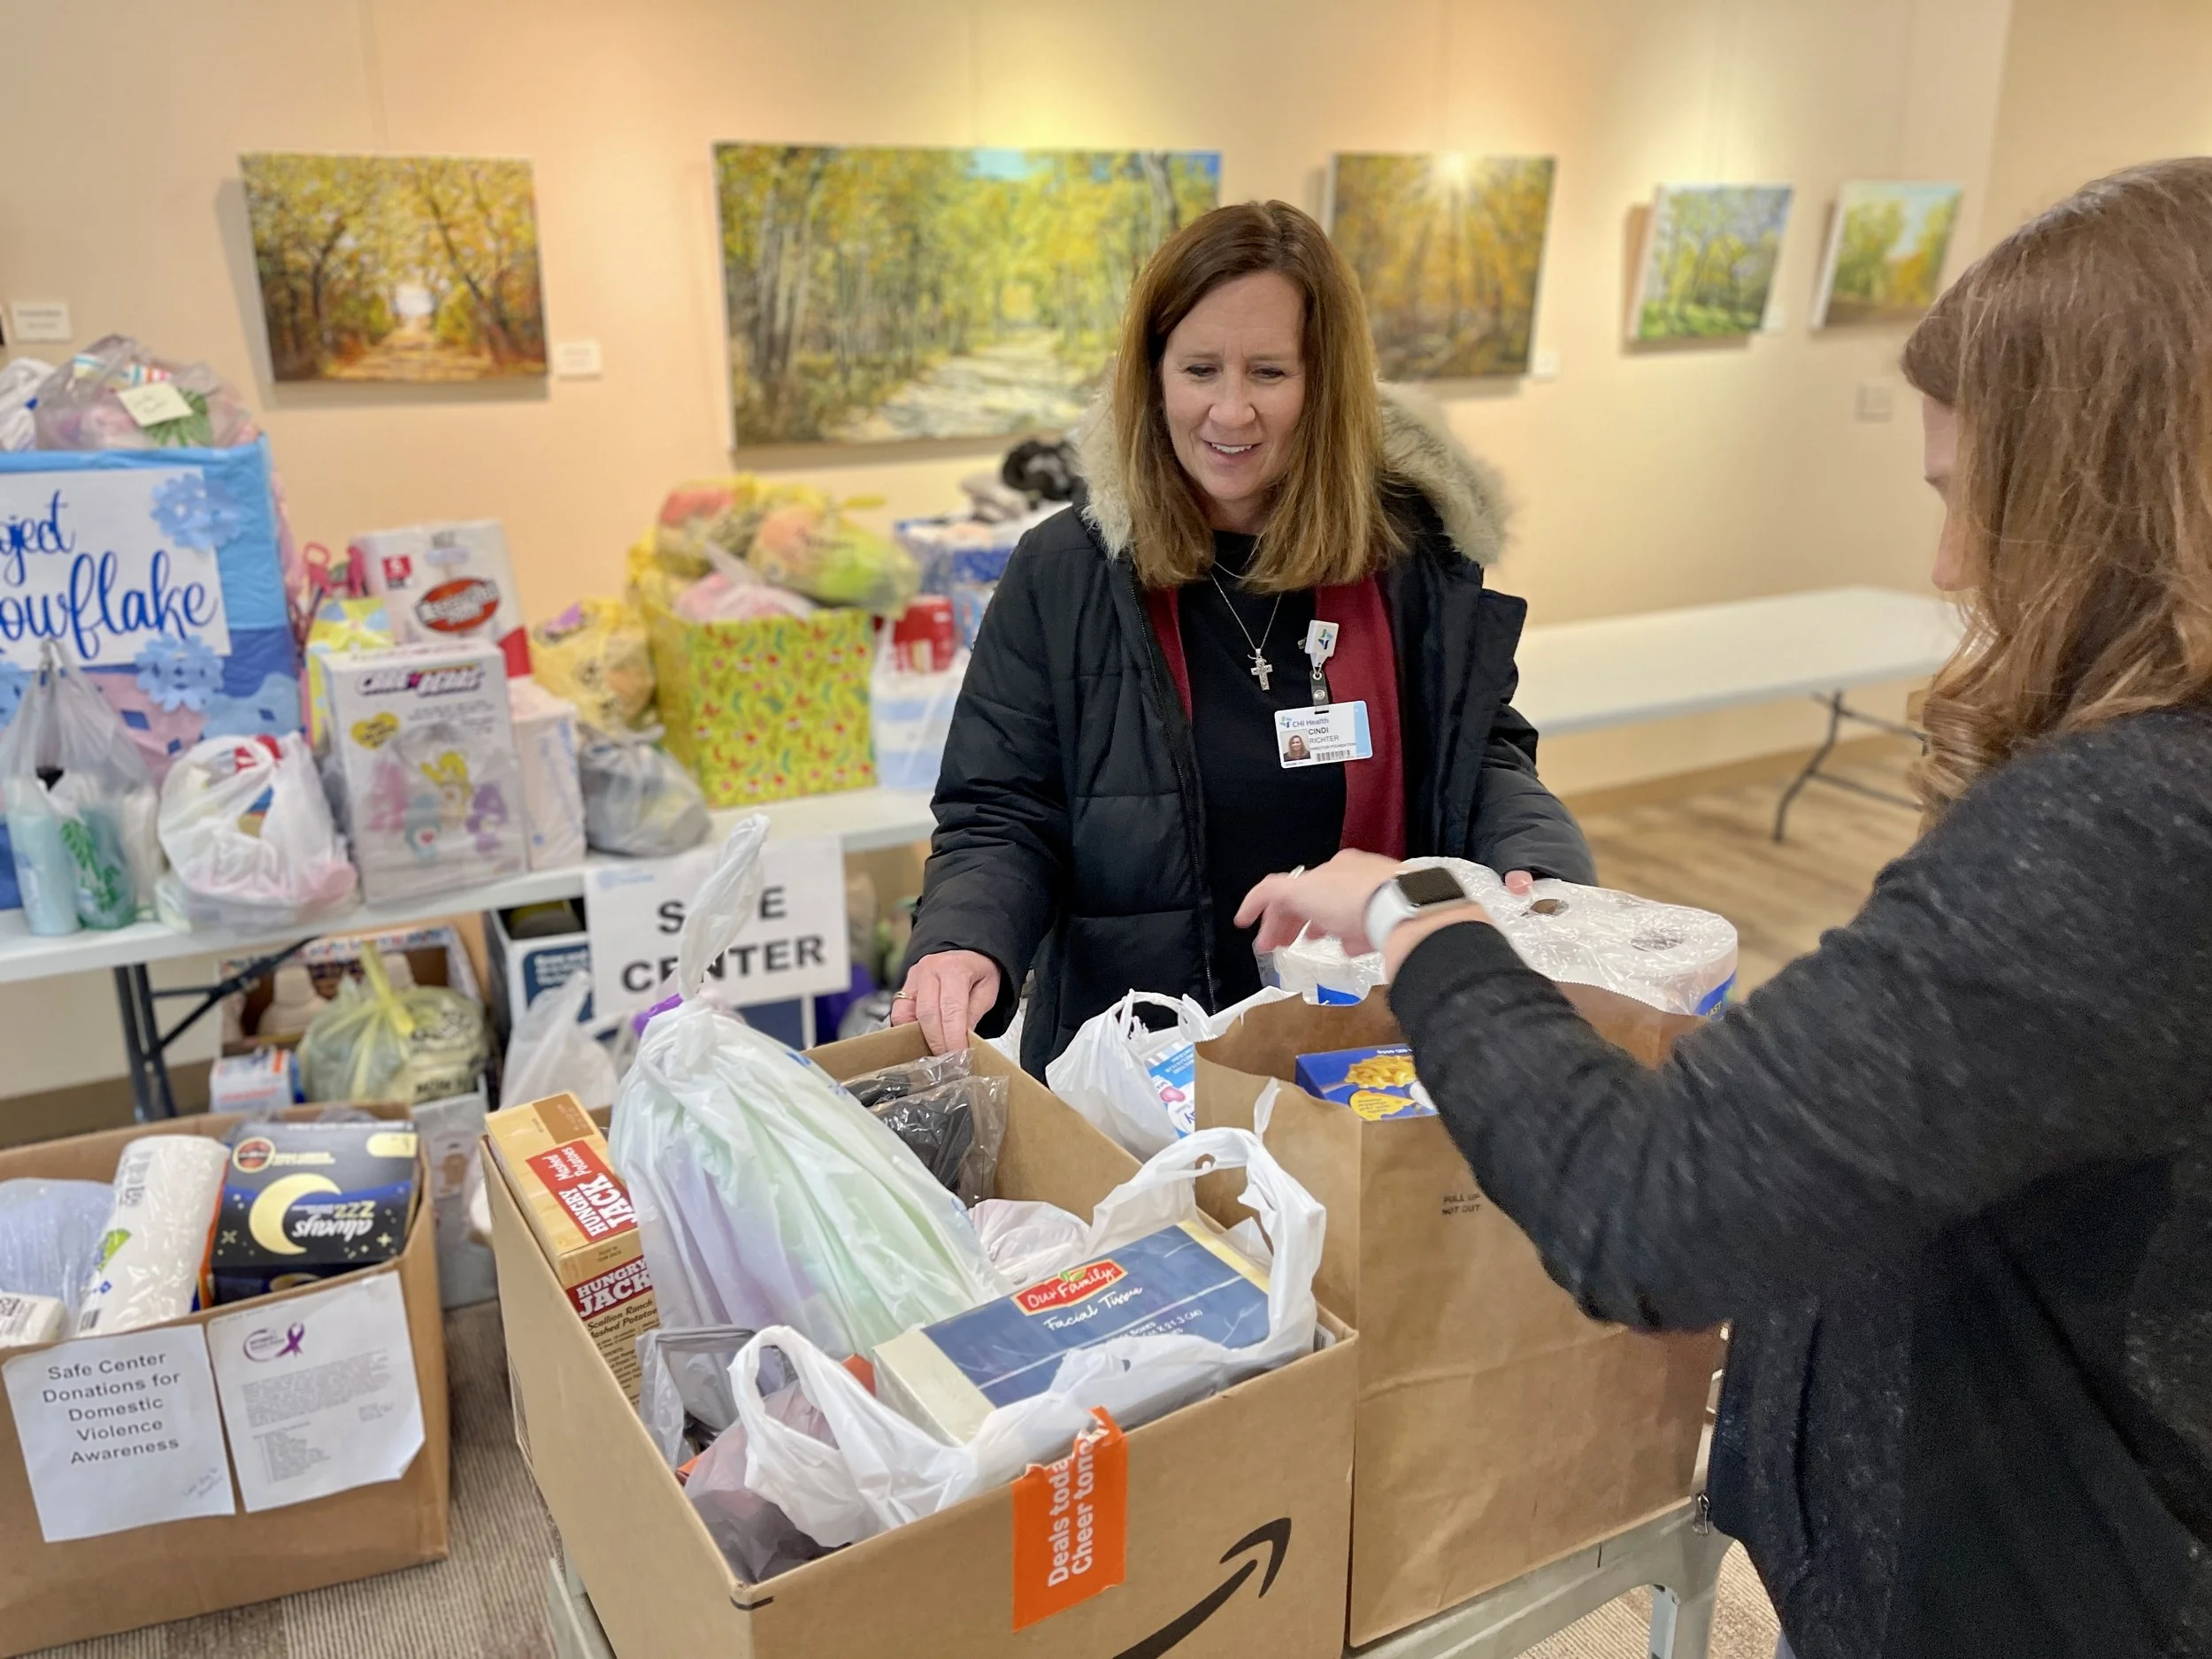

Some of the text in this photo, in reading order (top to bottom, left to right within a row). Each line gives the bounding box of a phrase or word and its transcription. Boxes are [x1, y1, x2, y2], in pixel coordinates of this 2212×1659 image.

[1306, 718, 1329, 726] Health
[1310, 735, 1340, 744] RICHTER
[657, 886, 787, 934] SE
[541, 1154, 574, 1181] Mashed
[561, 1147, 592, 1177] Potatoes
[558, 1187, 609, 1237] HUNGRY
[577, 1172, 638, 1229] JACK
[291, 1214, 373, 1242] always
[575, 1259, 647, 1298] HUNGRY
[580, 1271, 652, 1317] JACK
[1027, 1266, 1116, 1309] Our Family
[588, 1299, 653, 1331] Scallion Ranch
[623, 1308, 657, 1328] Potatoe
[1043, 1286, 1143, 1331] Facial Tissue
[48, 1353, 167, 1380] Safe Center
[42, 1371, 181, 1403] Donations for
[68, 1396, 165, 1422] Domestic
[76, 1419, 164, 1441] Violence
[70, 1438, 180, 1465] Awareness
[1048, 1460, 1071, 1587] Deals toda
[1071, 1503, 1094, 1575] Cheer
